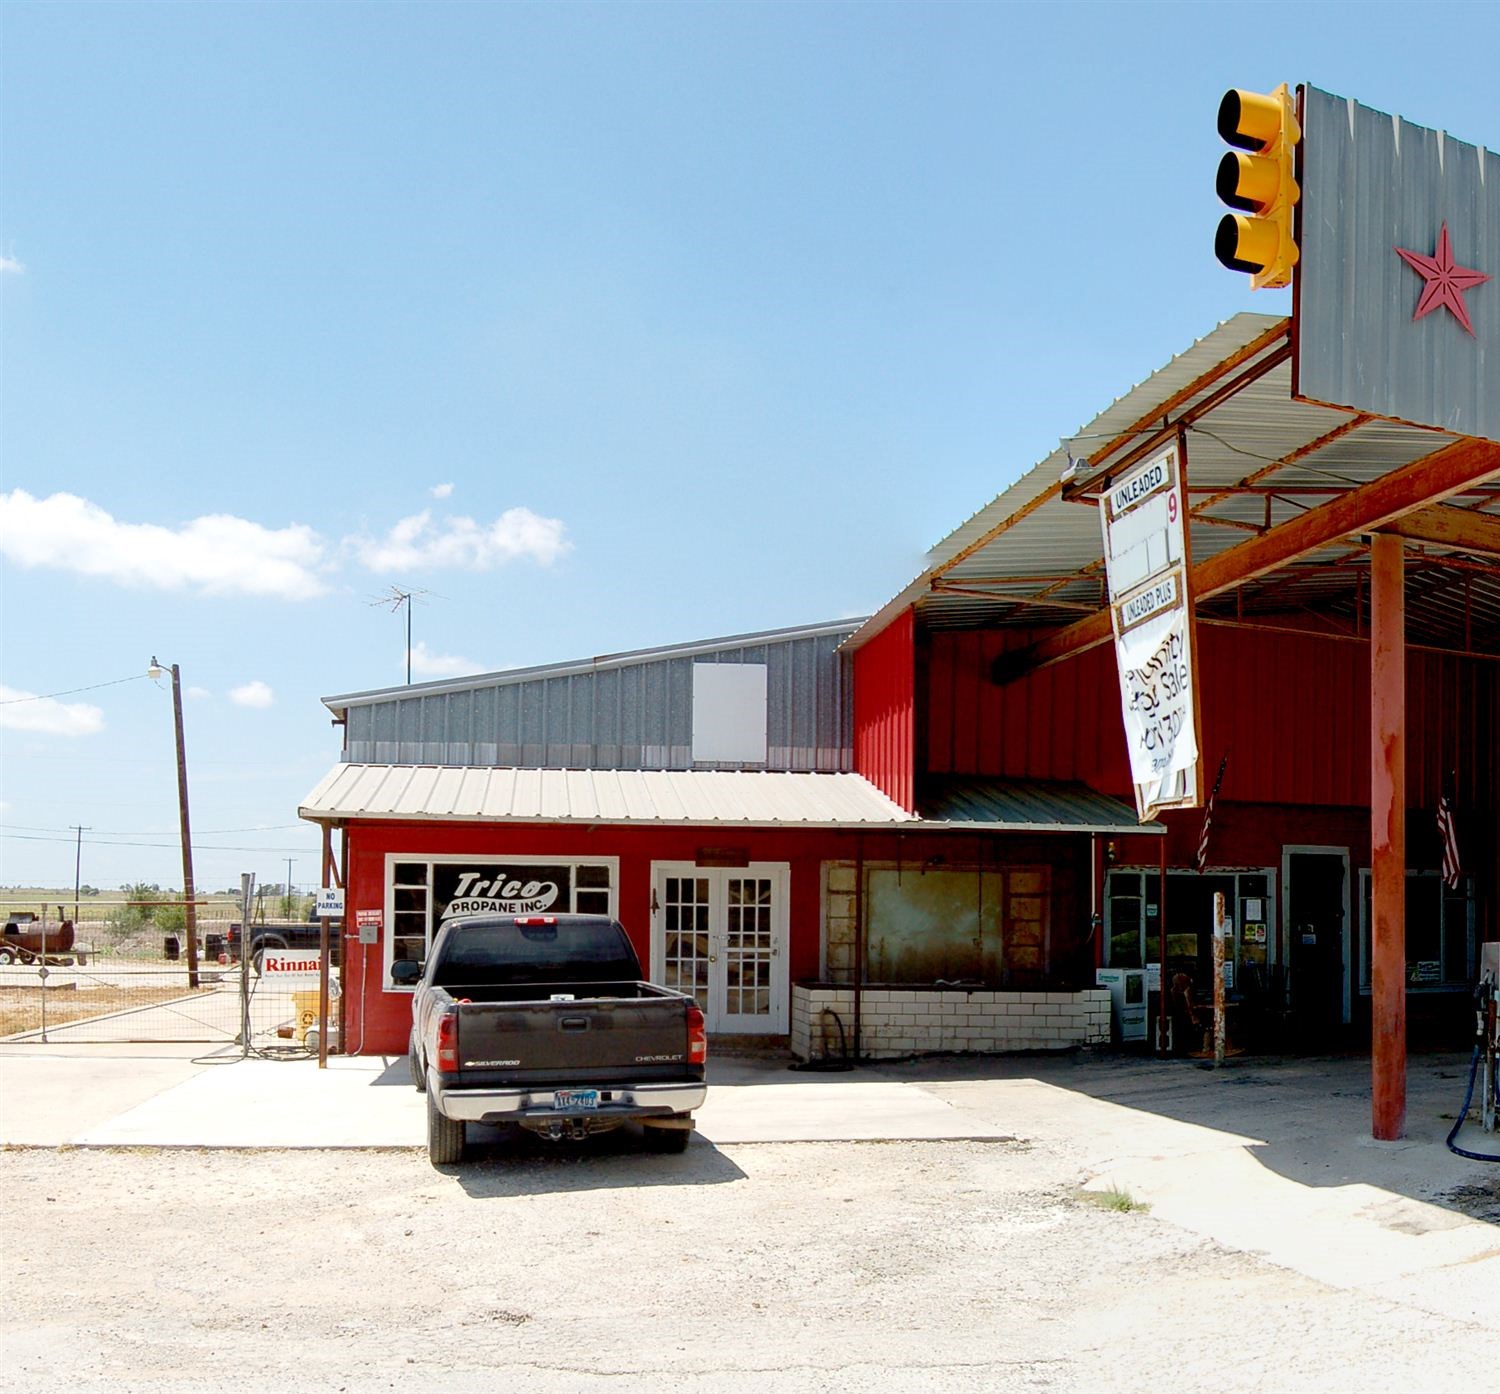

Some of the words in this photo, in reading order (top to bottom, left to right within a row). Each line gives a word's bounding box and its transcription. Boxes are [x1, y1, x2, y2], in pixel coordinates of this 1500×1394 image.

[1116, 465, 1162, 509] UNLEADED
[1168, 493, 1178, 523] 9
[1127, 591, 1155, 621] UNLEADED
[1156, 582, 1172, 607] PLUS
[1161, 663, 1188, 701] Sale
[454, 872, 542, 898] Trico
[451, 901, 516, 914] PROPANE
[521, 900, 548, 912] INC.
[475, 1059, 520, 1067] SILVERADO
[635, 1054, 683, 1062] CHEVROLET
